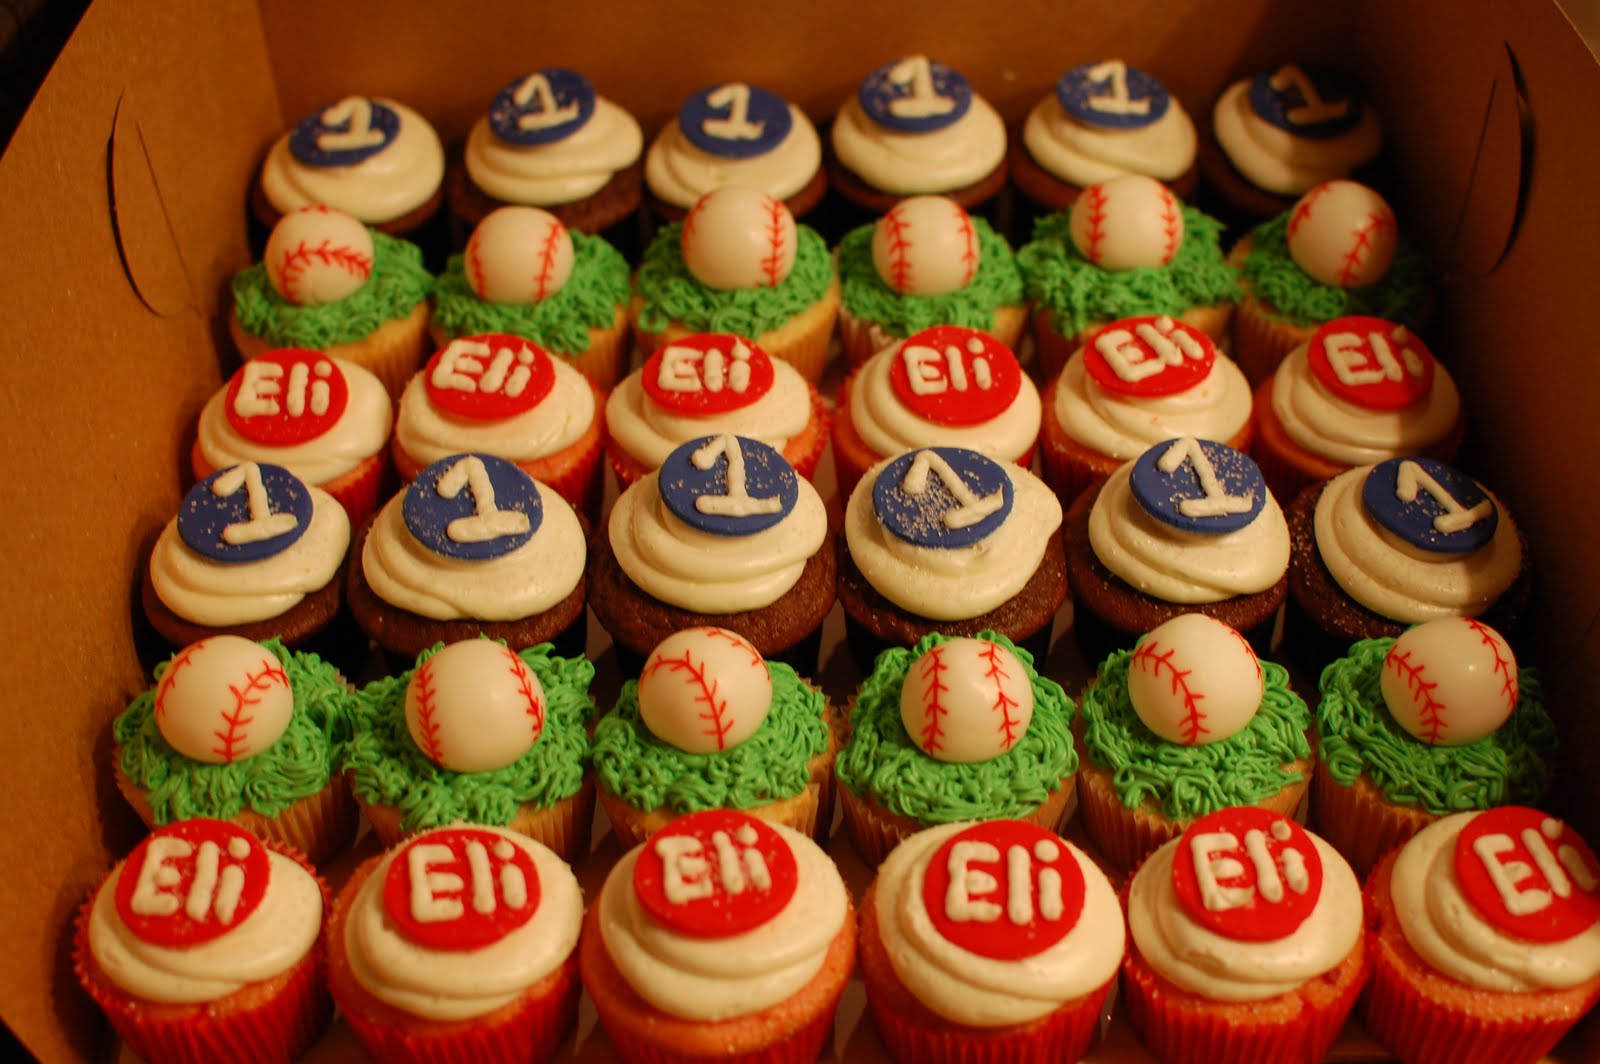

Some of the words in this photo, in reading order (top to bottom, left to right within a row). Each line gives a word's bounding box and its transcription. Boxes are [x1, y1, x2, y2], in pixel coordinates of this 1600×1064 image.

[514, 73, 579, 131] 1
[703, 83, 765, 140] 1
[889, 55, 956, 118] 1
[1088, 60, 1151, 115] 1
[1269, 65, 1351, 124] 1
[317, 97, 385, 151] 1
[431, 338, 534, 397] Eli
[658, 336, 754, 394] Eli
[903, 338, 993, 395] Eli
[1095, 315, 1205, 383] Eli
[1325, 324, 1425, 385] Eli
[234, 361, 332, 417] Eli
[212, 462, 298, 545] 1
[437, 455, 531, 543] 1
[691, 433, 783, 517] 1
[903, 450, 1004, 529] 1
[1158, 436, 1252, 517] 1
[1396, 459, 1493, 532] 1
[131, 836, 251, 924] Eli
[409, 838, 526, 923] Eli
[655, 824, 772, 904] Eli
[945, 839, 1062, 925] Eli
[1190, 819, 1309, 910] Eli
[1473, 818, 1598, 915] Eli
